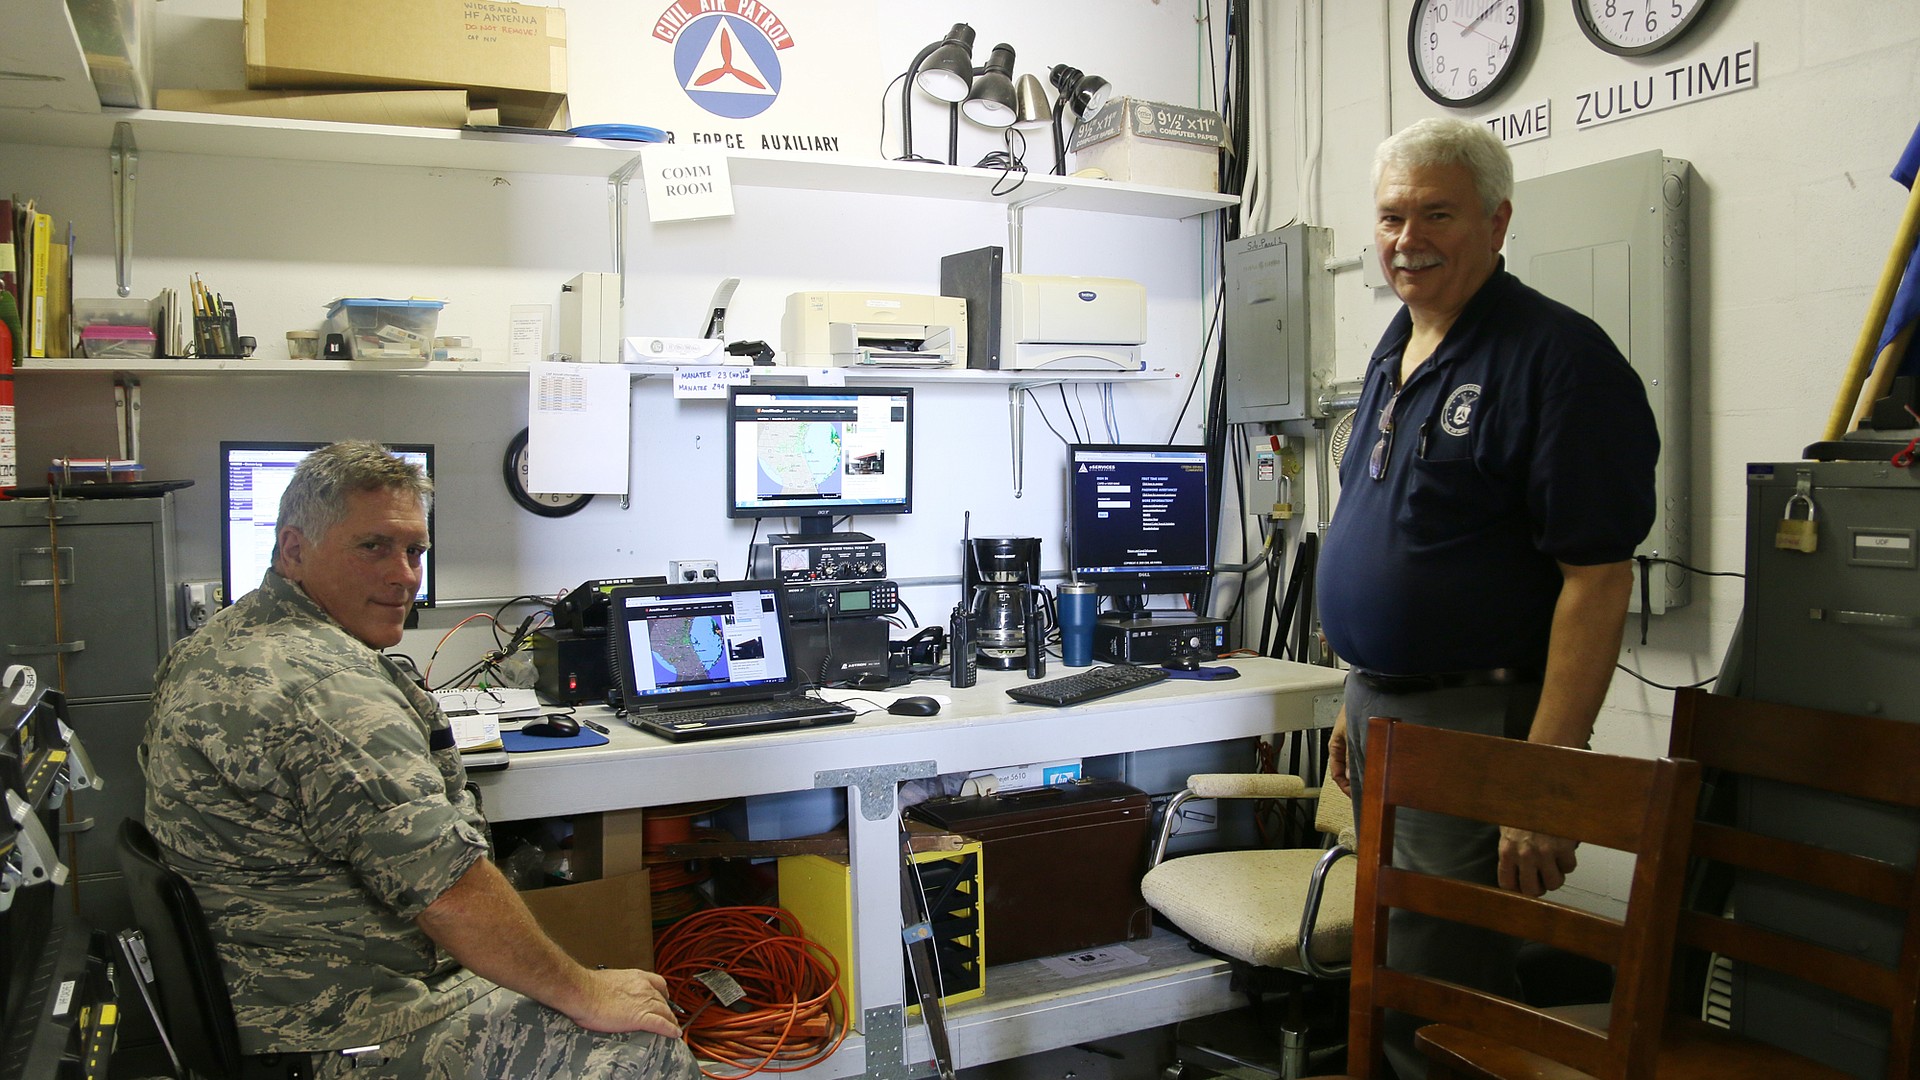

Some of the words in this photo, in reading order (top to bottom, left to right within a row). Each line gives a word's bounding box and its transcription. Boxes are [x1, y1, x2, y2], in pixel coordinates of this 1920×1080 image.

[464, 3, 517, 14] WIDEBAND
[1433, 4, 1448, 23] 10
[1506, 5, 1516, 25] 3
[1605, 0, 1616, 17] 8
[464, 11, 480, 19] HF
[483, 14, 537, 25] ANTENNA
[656, 3, 692, 39] CIVIL
[701, 0, 727, 12] AIR
[738, 0, 790, 47] PATROL
[1622, 10, 1634, 32] 7
[1645, 11, 1657, 32] 6
[502, 27, 537, 36] REMOVE!
[1430, 32, 1438, 50] 9
[1499, 35, 1510, 53] 4
[1436, 56, 1445, 73] 8
[1487, 55, 1496, 75] 5
[1450, 68, 1459, 86] 7
[1468, 68, 1477, 86] 6
[1576, 77, 1653, 124] ZULU
[1665, 49, 1751, 100] TIME
[1487, 105, 1547, 141] TIME
[761, 134, 839, 152] AUXILIARY
[1159, 127, 1196, 139] COMPUTER
[1197, 134, 1219, 142] PAPER
[662, 166, 711, 179] COMM
[666, 182, 713, 196] ROOM
[681, 371, 711, 379] MANATEE
[521, 464, 529, 475] 9
[551, 493, 559, 502] 6
[1011, 772, 1027, 781] 5610
